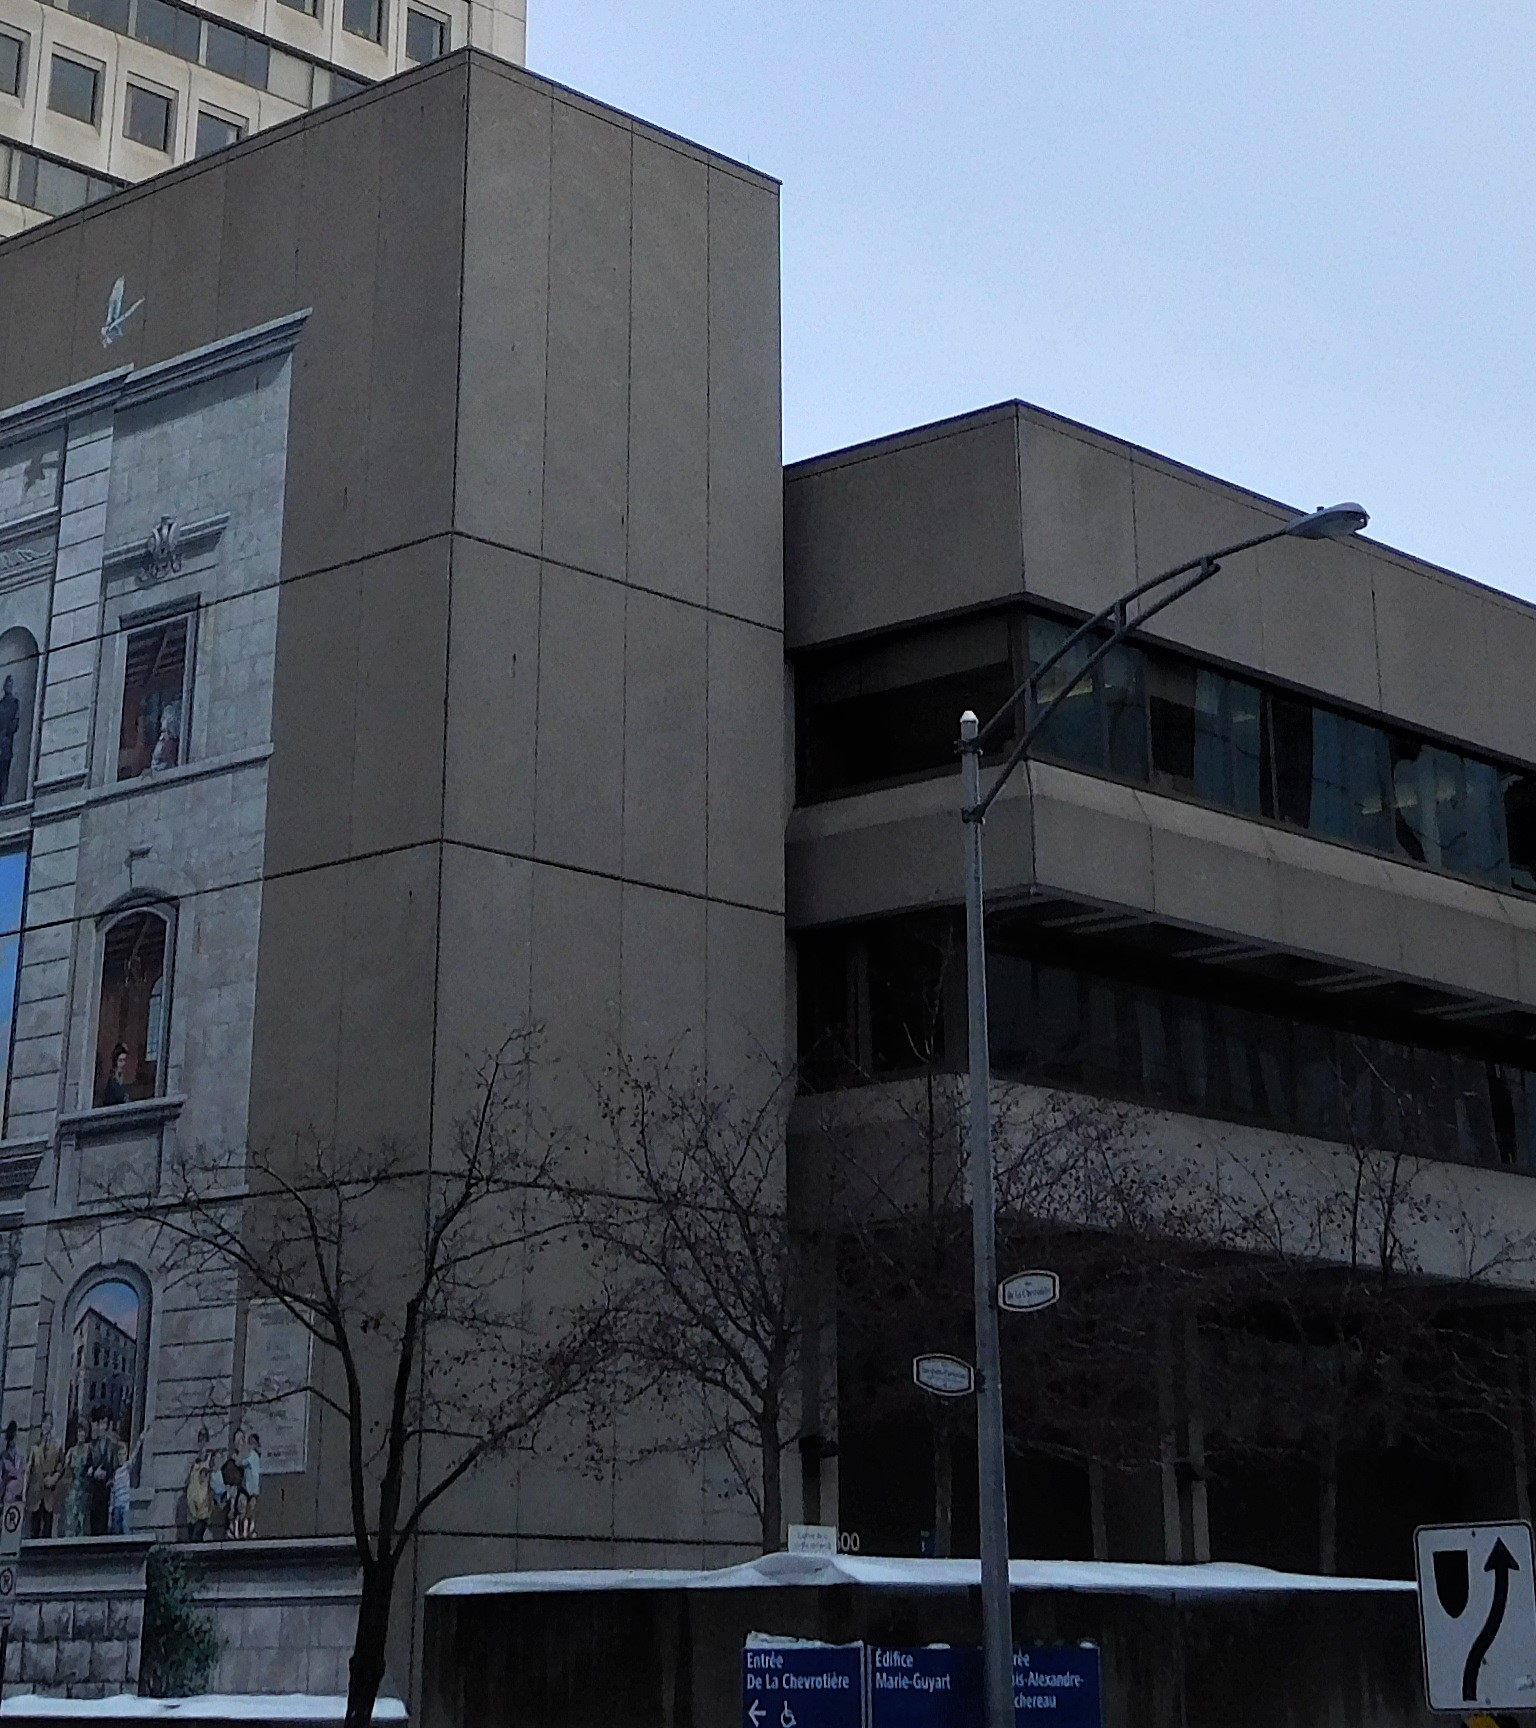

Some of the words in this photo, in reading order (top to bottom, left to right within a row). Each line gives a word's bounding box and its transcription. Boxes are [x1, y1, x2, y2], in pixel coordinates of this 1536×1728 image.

[837, 1531, 861, 1552] 00
[746, 1650, 784, 1669] Entrée
[875, 1648, 914, 1668] Édifice
[1013, 1649, 1031, 1668] rée
[746, 1673, 763, 1690] De
[765, 1673, 779, 1690] La
[782, 1671, 850, 1690] Chevrotière
[875, 1671, 952, 1692] Marie-Guyart
[1014, 1691, 1057, 1709] chereau
